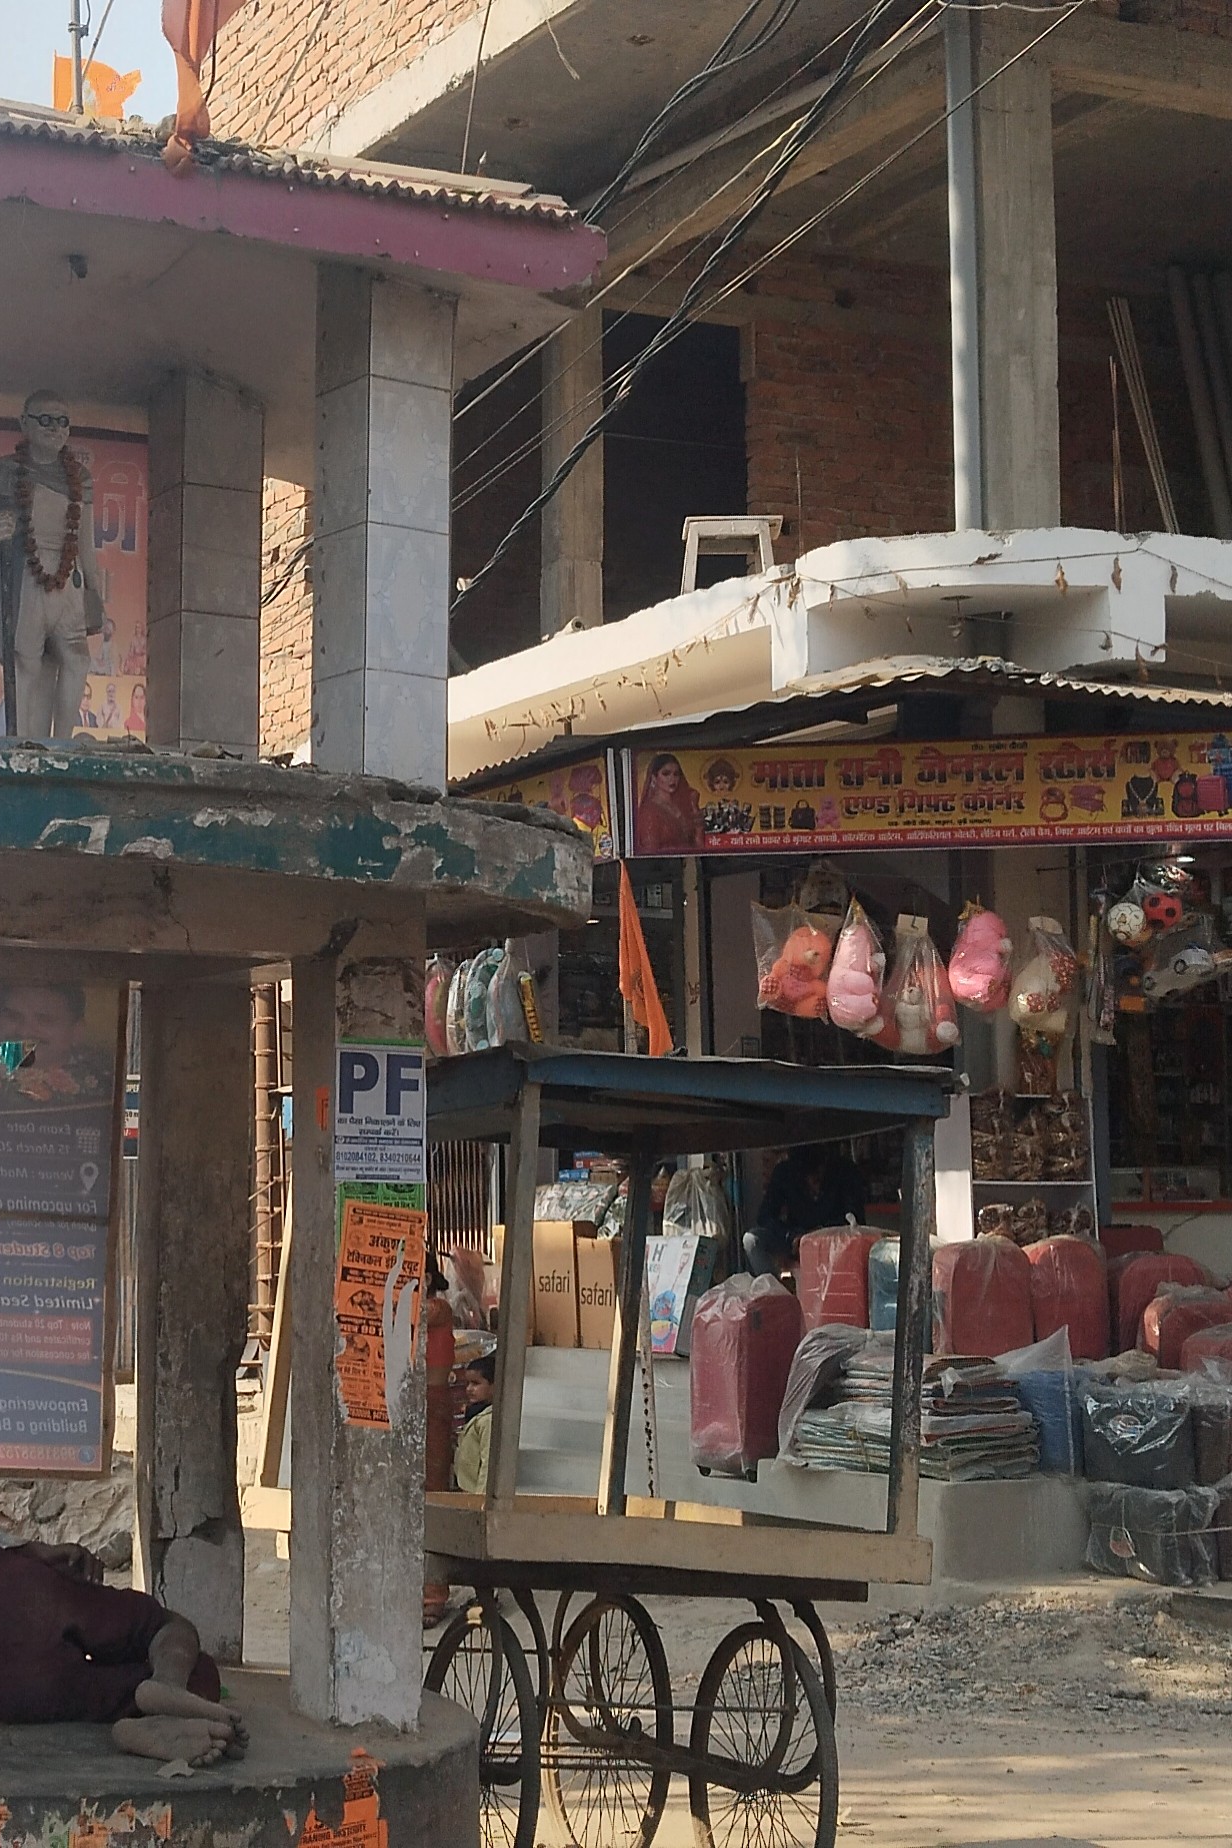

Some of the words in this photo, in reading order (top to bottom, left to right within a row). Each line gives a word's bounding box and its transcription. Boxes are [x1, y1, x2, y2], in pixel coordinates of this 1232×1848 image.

[751, 759, 828, 790] माता
[835, 747, 905, 788] रानी
[914, 745, 1027, 785] जेनरल
[1036, 739, 1118, 781] स्टोर्स
[842, 795, 891, 818] एण्ड
[896, 788, 957, 817] गिफ्ट
[960, 785, 1027, 813] कॉर्नर
[745, 834, 761, 845] सभी
[762, 835, 781, 845] प्रकार
[782, 833, 790, 843] के
[1055, 825, 1074, 836] गिफ्ट
[1133, 824, 1143, 833] का
[1203, 822, 1213, 831] पर
[339, 1051, 422, 1115] PF
[349, 1115, 363, 1125] पैसा
[365, 1115, 395, 1126] निकालने
[397, 1117, 405, 1126] के
[407, 1117, 421, 1128] लिए
[539, 1269, 570, 1293] safari
[580, 1281, 613, 1307] safari
